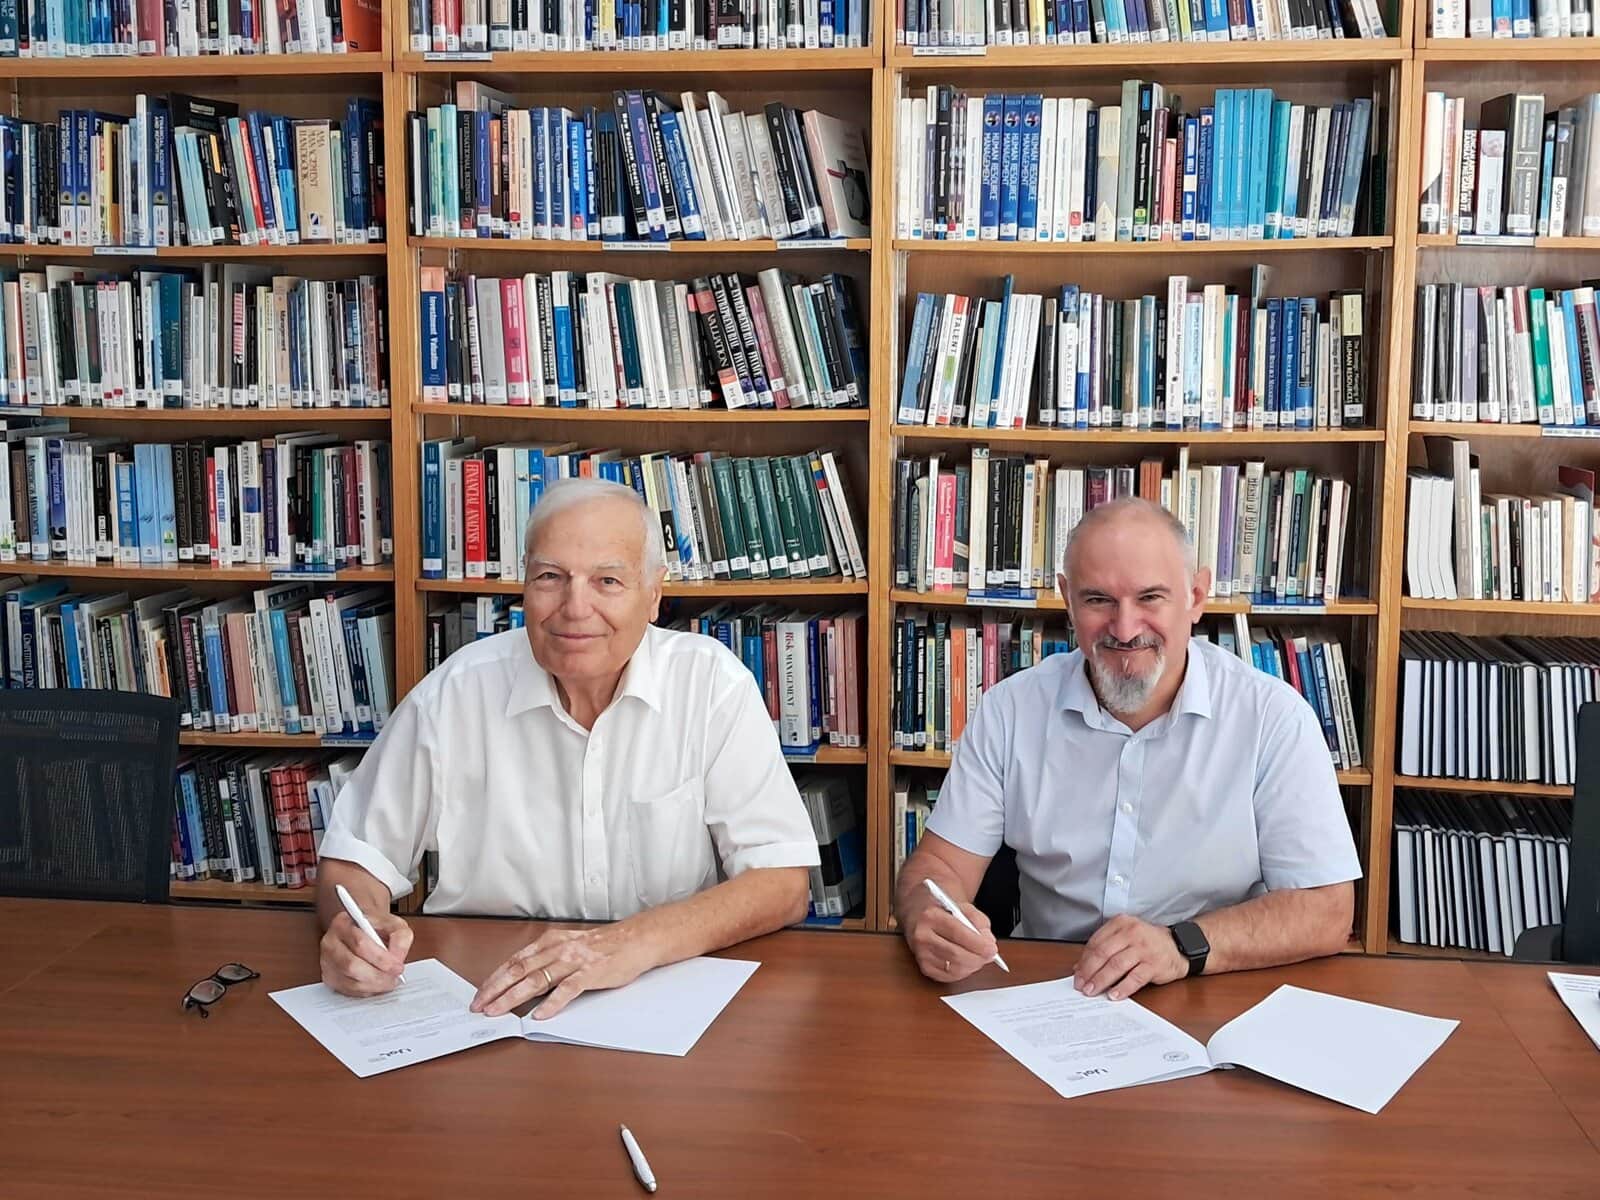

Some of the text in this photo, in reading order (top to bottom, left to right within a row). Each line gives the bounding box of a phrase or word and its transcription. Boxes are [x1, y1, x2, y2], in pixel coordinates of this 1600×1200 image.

[536, 125, 544, 161] Technology
[553, 125, 561, 161] Technology
[625, 131, 635, 161] Venture
[630, 163, 642, 195] Creation
[655, 131, 665, 160] Venture
[661, 162, 671, 194] Creation
[990, 133, 999, 201] HUMAN RESOURCE
[1009, 133, 1019, 201] HUMAN RESOURCE
[1022, 133, 1030, 186] MANAGEMENT
[1028, 133, 1039, 201] HUMAN RESOURCE
[1199, 128, 1207, 180] Management
[736, 151, 753, 193] CORPORATE
[760, 151, 777, 193] CORPORATE
[1555, 183, 1565, 212] dyson
[429, 296, 438, 370] Investment Valuation
[706, 313, 730, 369] VALUATION
[950, 316, 963, 355] TALENT
[217, 469, 226, 523] CORPORATE COMBAT
[465, 464, 480, 544] FINANCIAL ANALYSIS
[1243, 477, 1259, 555] Clash of Cultures
[665, 524, 675, 548] 3
[22, 633, 35, 689] COMPETITIVE FRON
[182, 630, 199, 719] SHORT-TERM AMERICA
[785, 631, 795, 707] Risk MANAGEMENT
[227, 771, 242, 828] FAMILY WARS
